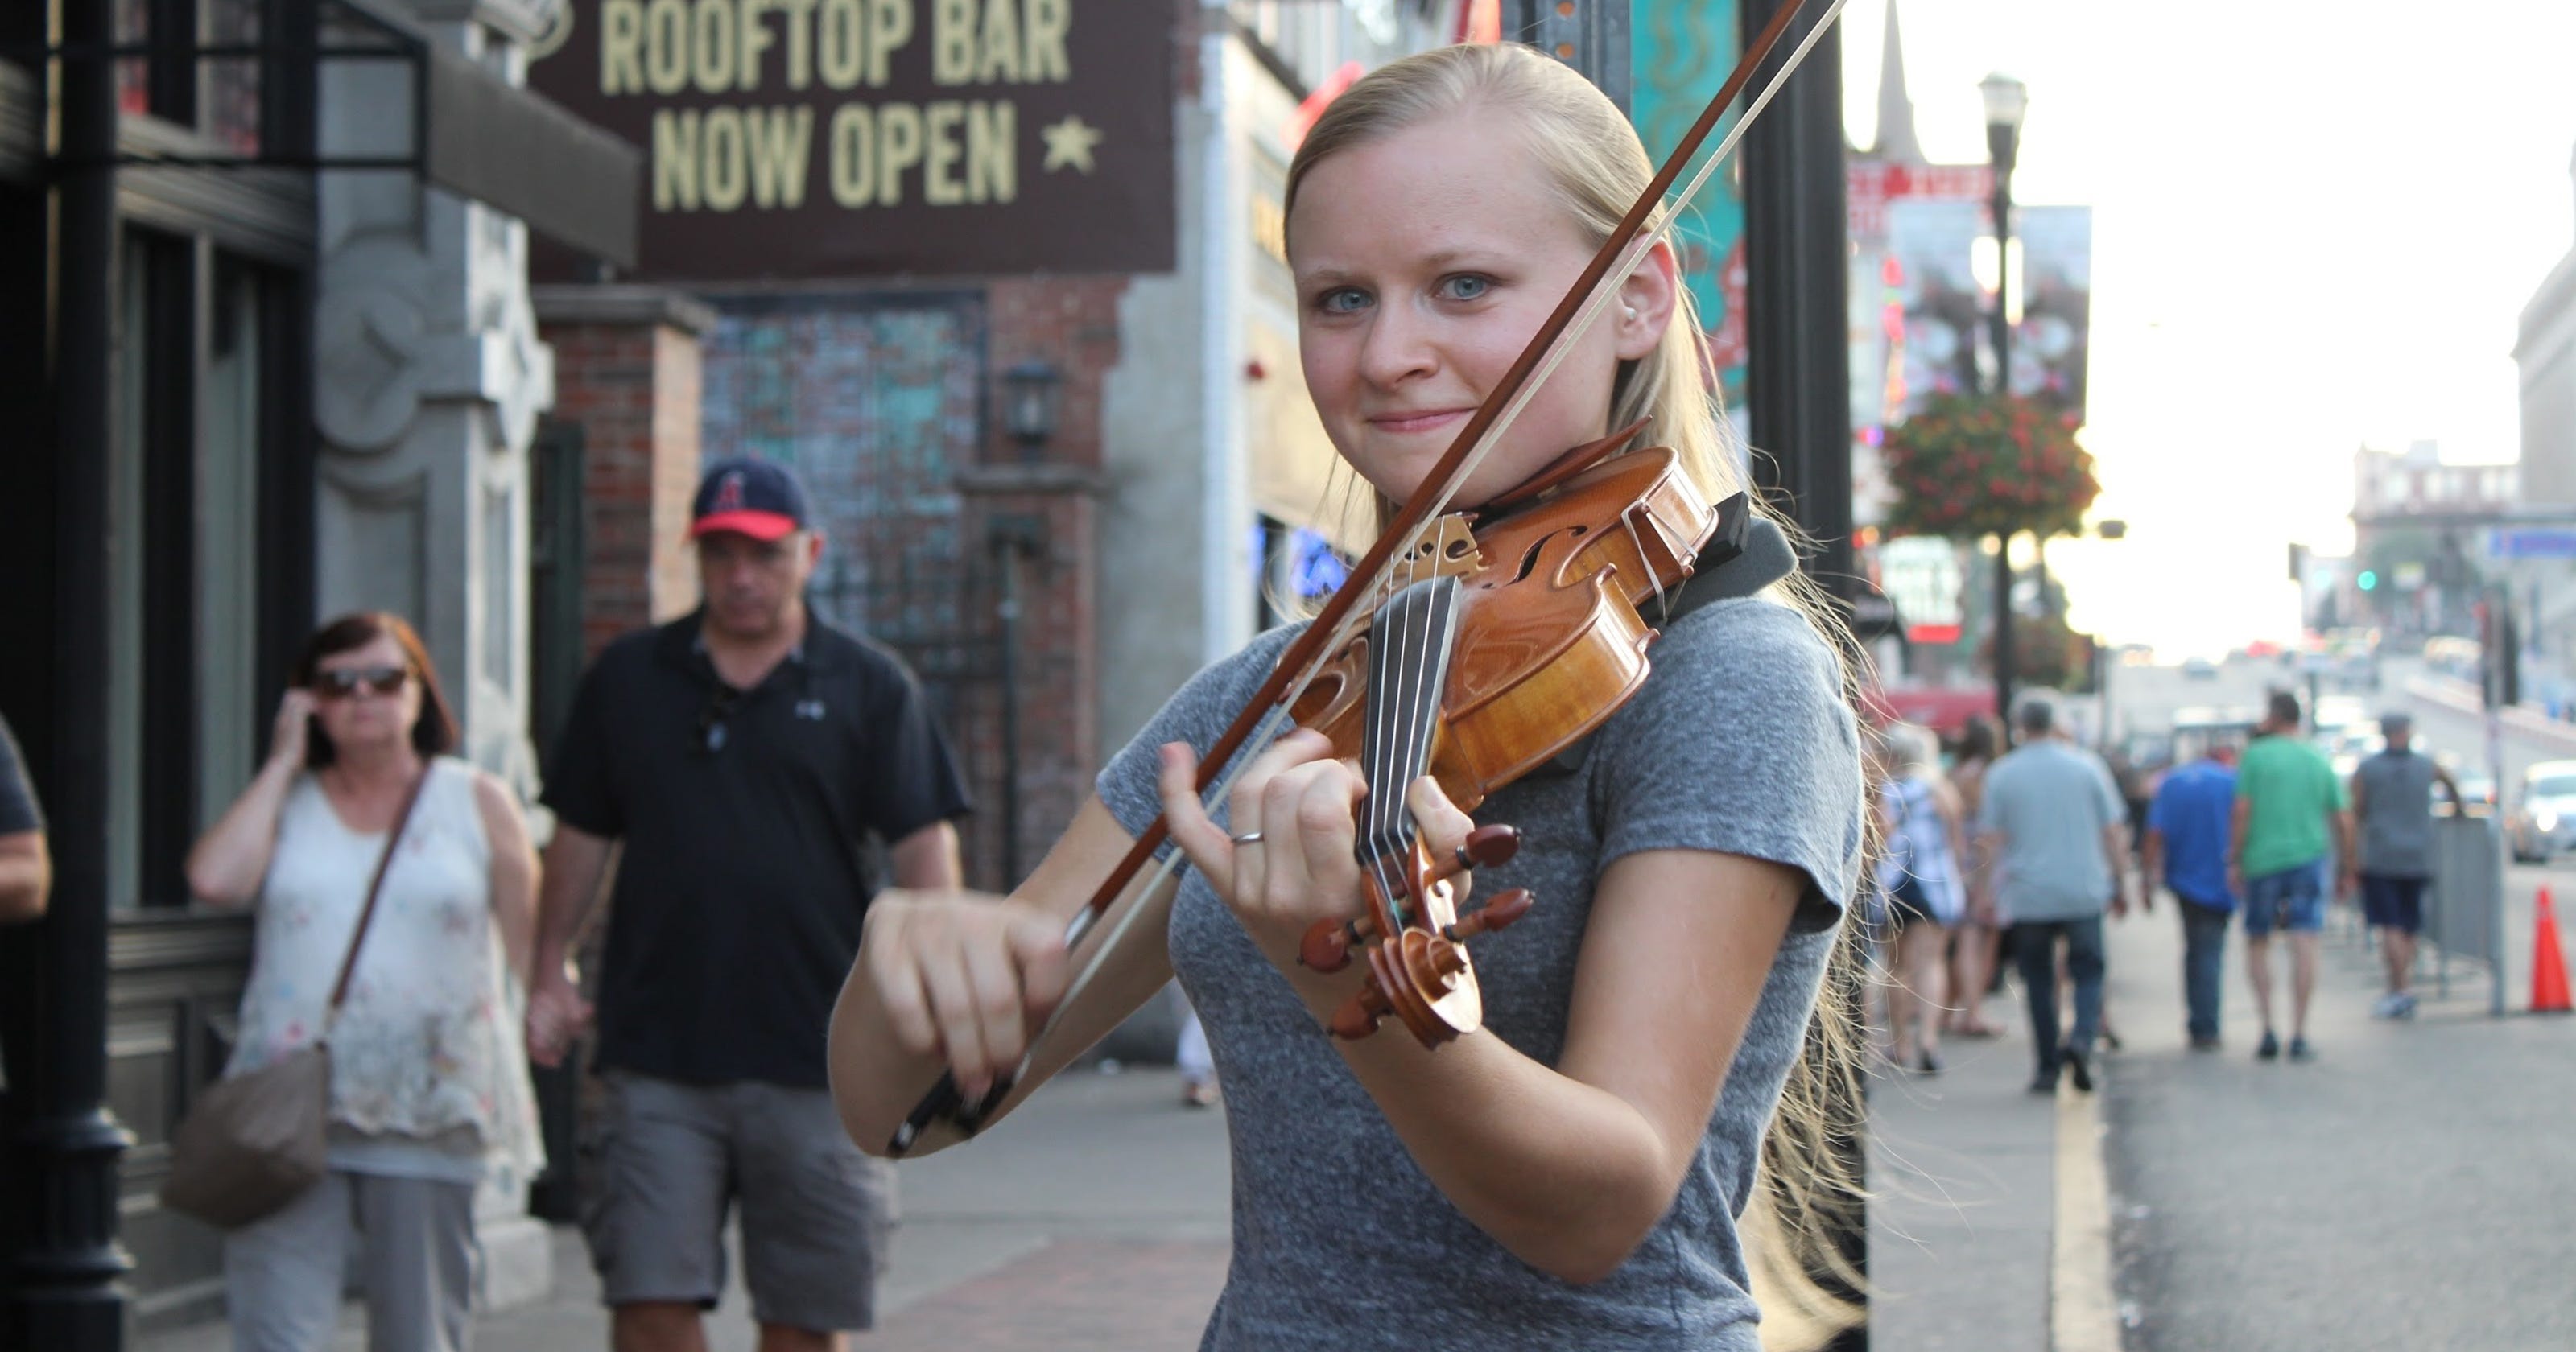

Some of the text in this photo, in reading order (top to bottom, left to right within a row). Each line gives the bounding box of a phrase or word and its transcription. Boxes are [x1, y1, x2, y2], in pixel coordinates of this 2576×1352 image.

[600, 0, 1071, 93] ROOFTOP BAR
[653, 101, 1015, 211] NOW OPEN
